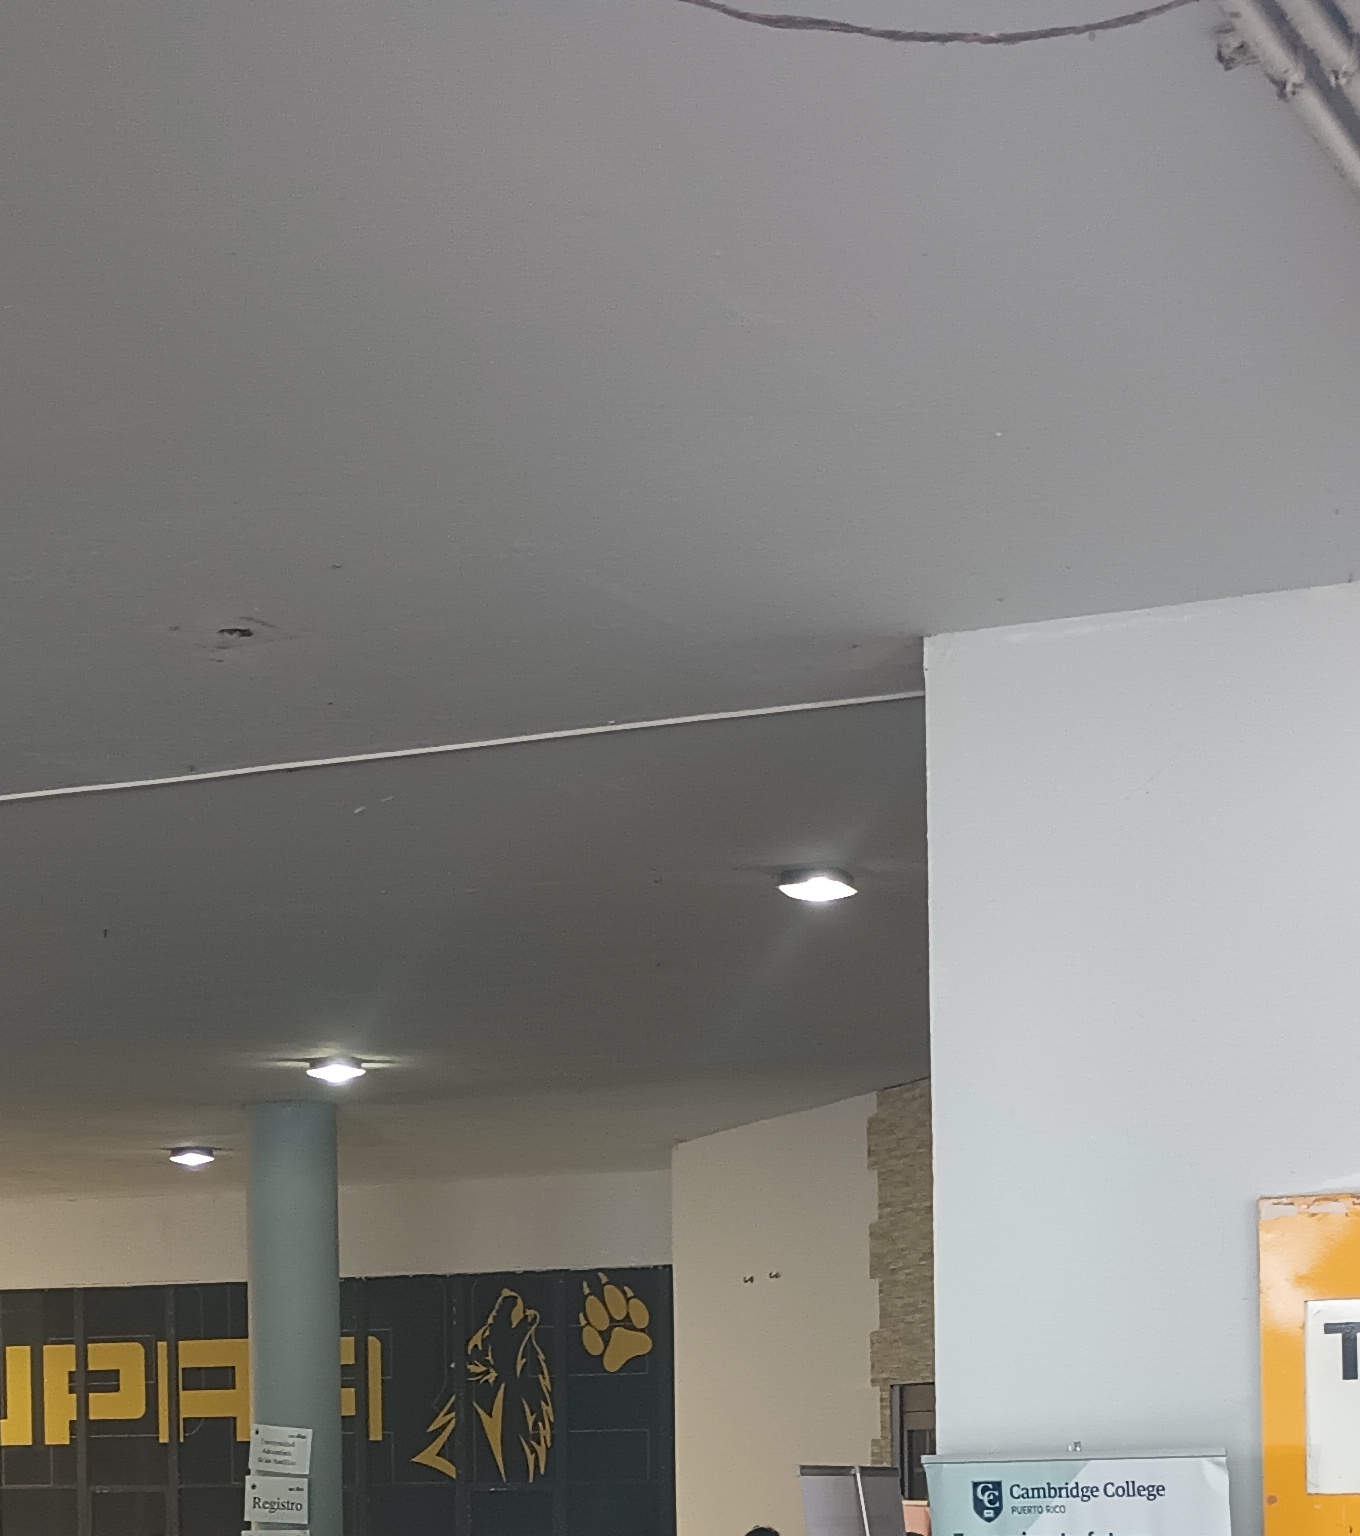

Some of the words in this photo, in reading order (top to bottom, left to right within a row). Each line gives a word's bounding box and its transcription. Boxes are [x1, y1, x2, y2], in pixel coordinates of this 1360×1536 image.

[1010, 1482, 1099, 1502] Cambridge
[1103, 1480, 1166, 1502] College
[253, 1497, 303, 1513] Registro
[1011, 1505, 1043, 1515] PUERTO
